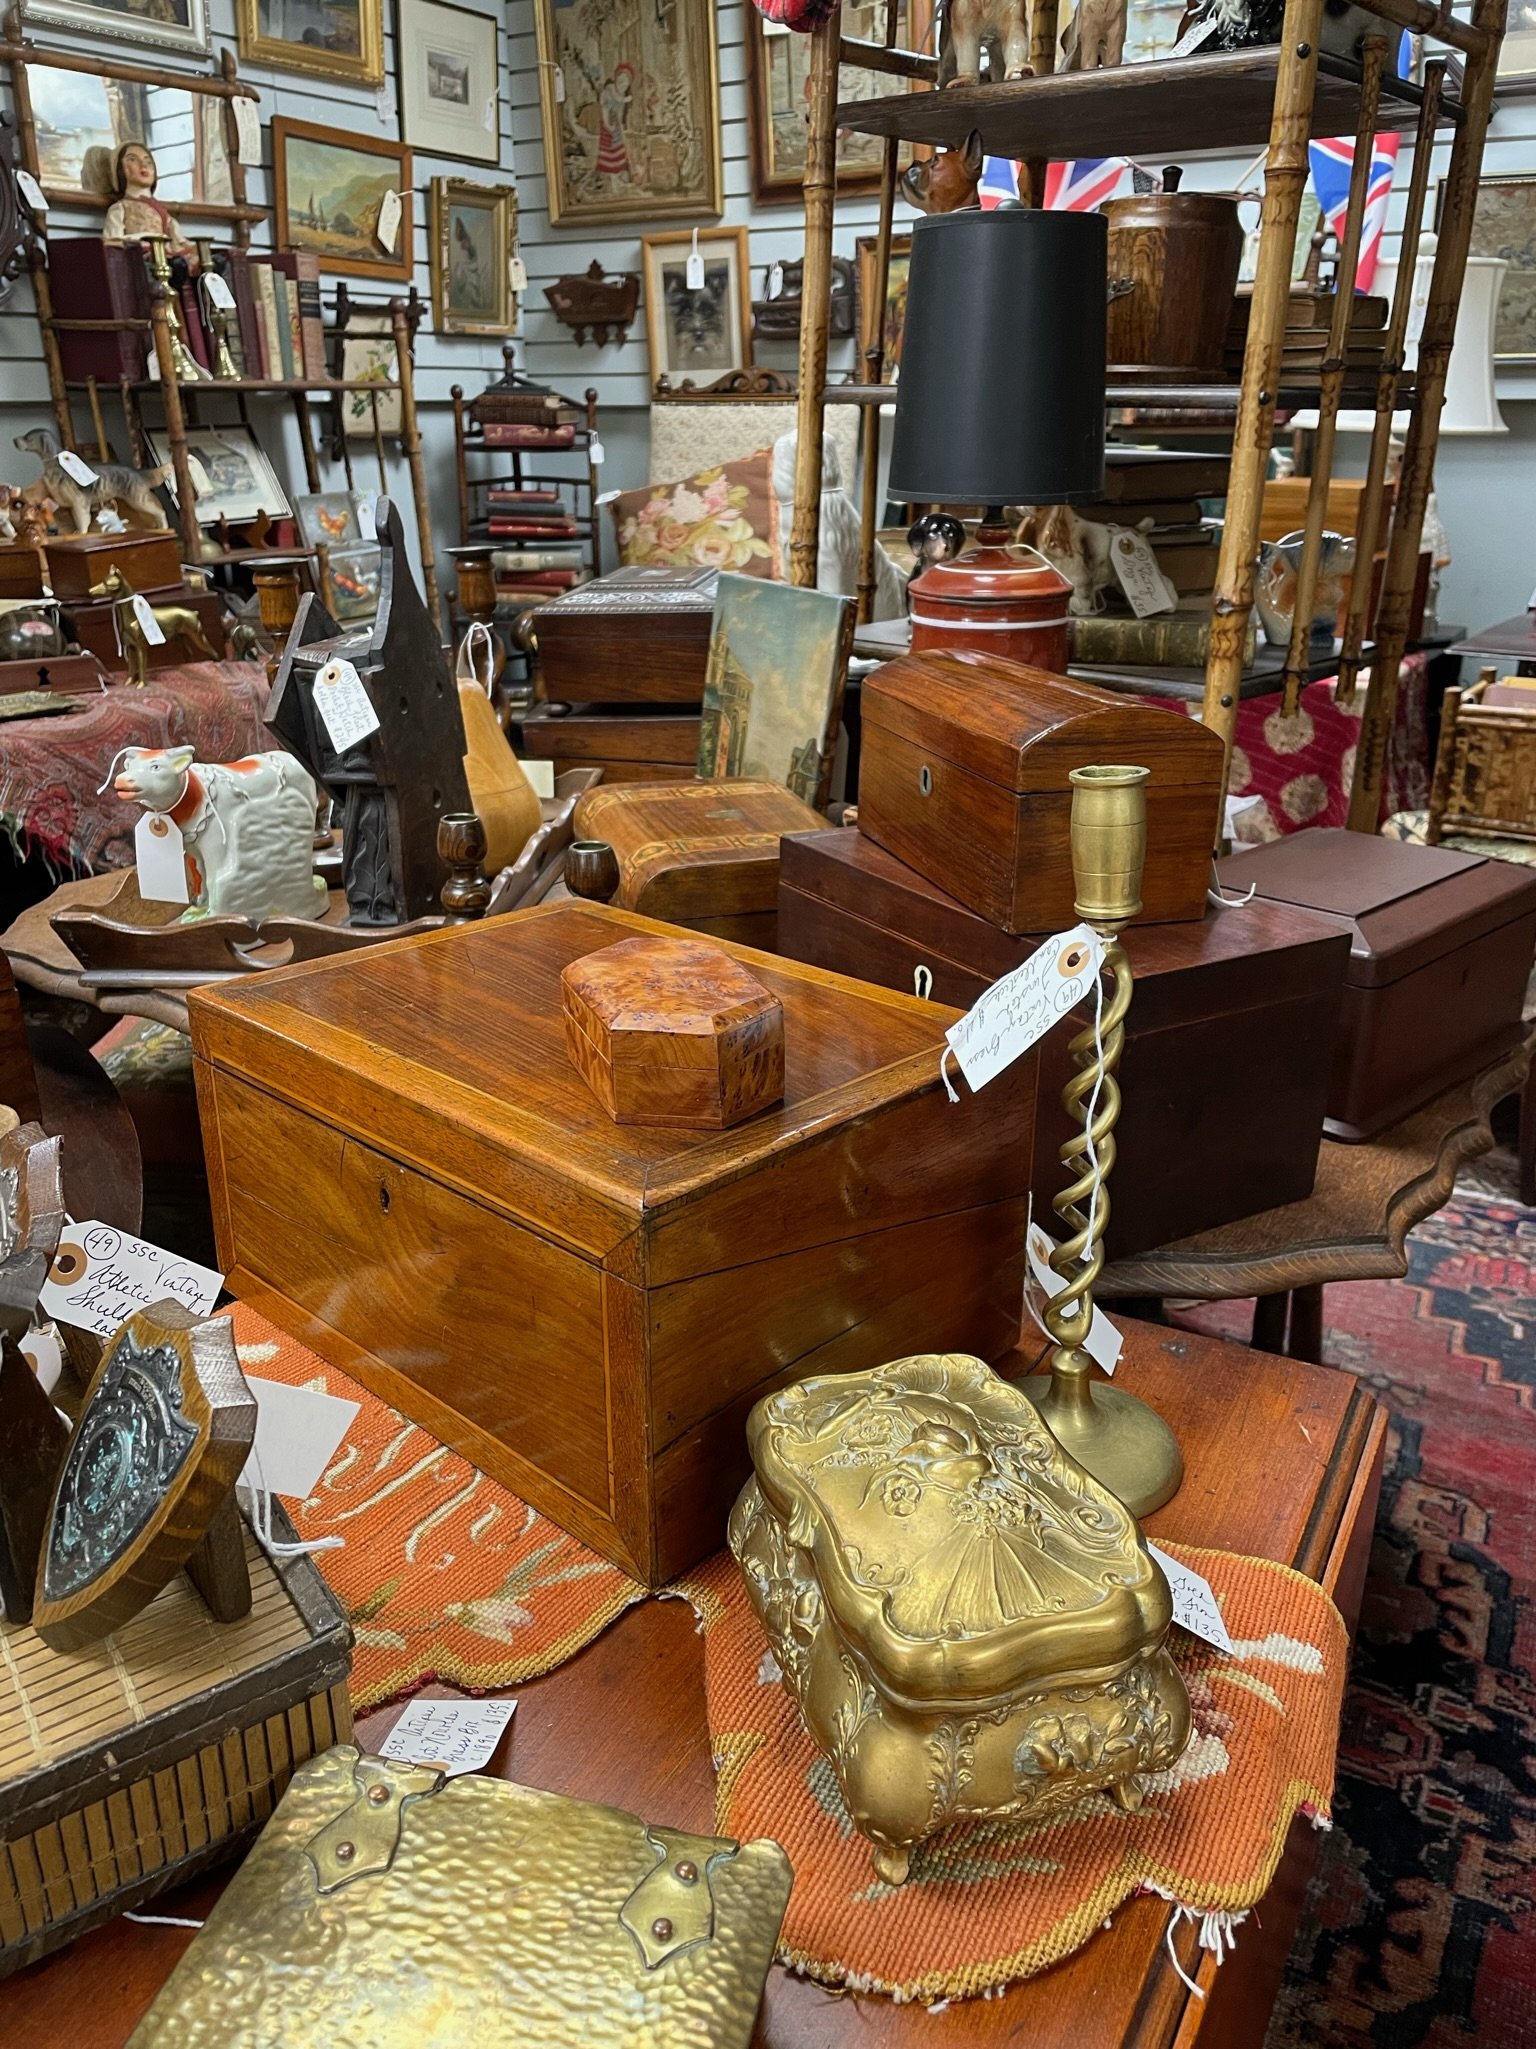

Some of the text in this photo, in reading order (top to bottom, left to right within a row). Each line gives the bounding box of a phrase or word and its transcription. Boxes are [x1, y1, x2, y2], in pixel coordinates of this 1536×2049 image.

[1000, 995, 1051, 1037] Vintage
[87, 1230, 117, 1255] 49
[155, 1261, 213, 1311] Vintage
[88, 1263, 154, 1304] Athletic
